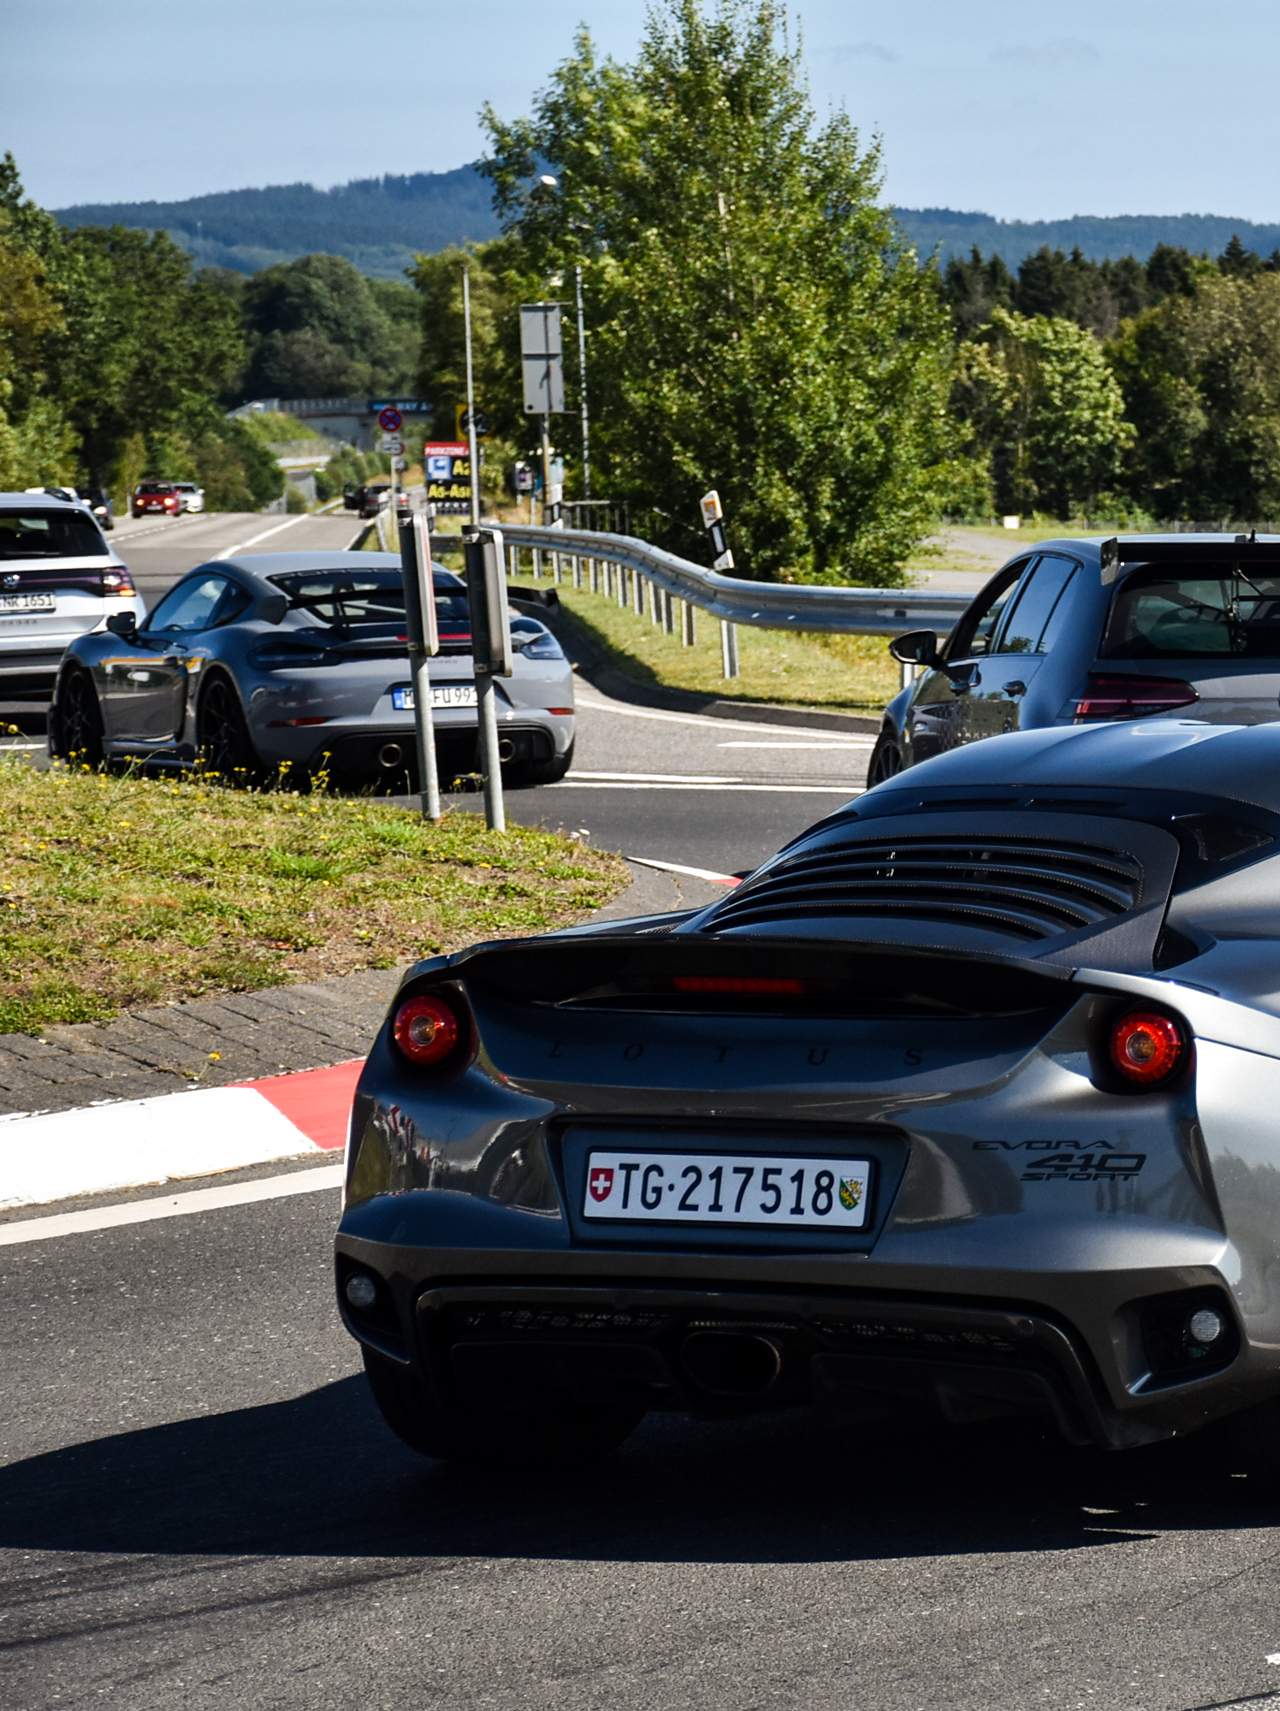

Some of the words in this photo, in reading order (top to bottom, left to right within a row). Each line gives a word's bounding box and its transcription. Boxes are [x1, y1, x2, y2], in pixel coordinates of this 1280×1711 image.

[22, 593, 52, 606] 1651
[433, 688, 451, 703] FU
[548, 1042, 923, 1067] LOTUS
[972, 1140, 1115, 1151] EVORA
[1026, 1153, 1147, 1172] 410
[1020, 1172, 1139, 1182] SPORT
